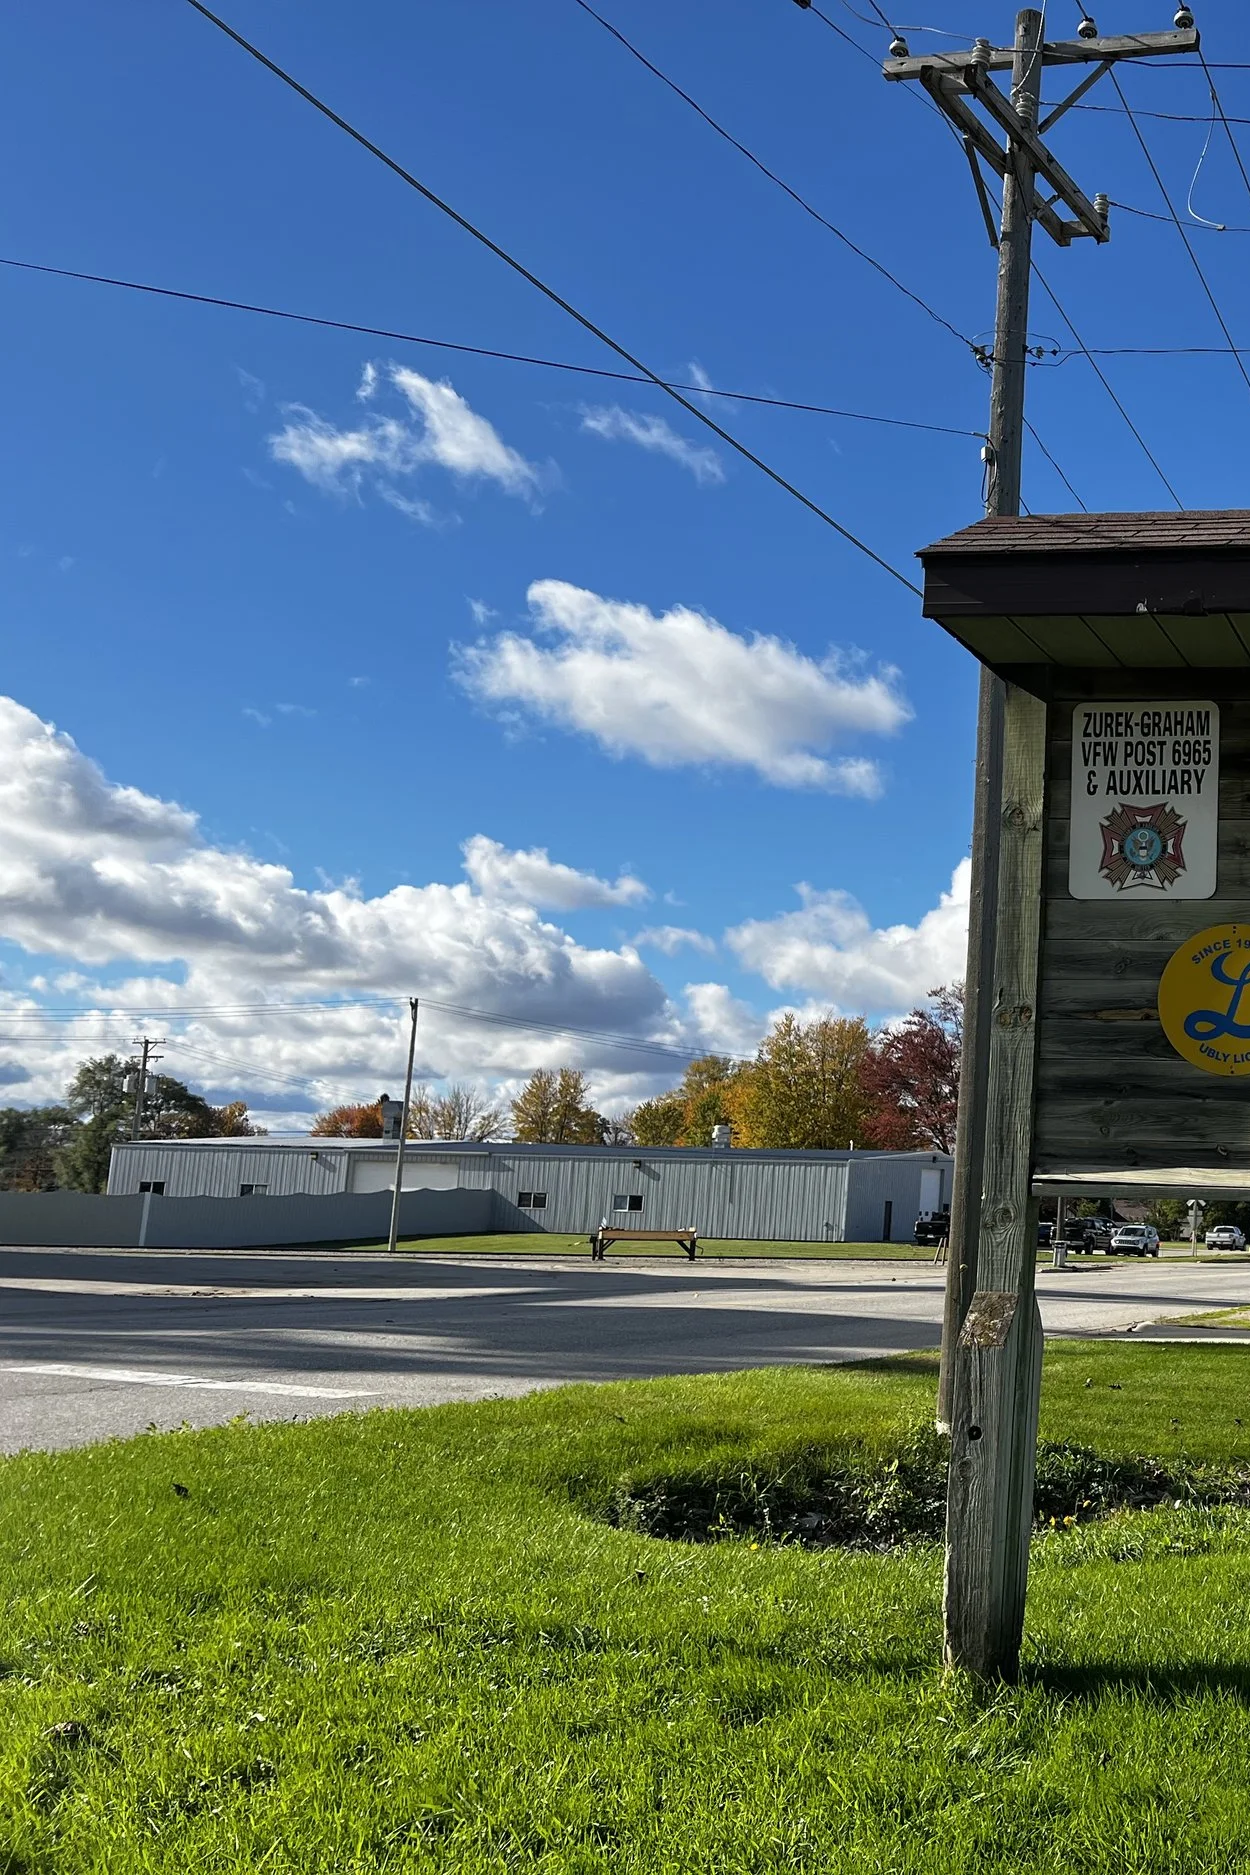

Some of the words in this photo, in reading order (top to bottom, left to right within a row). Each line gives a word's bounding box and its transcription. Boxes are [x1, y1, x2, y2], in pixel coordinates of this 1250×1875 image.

[1083, 710, 1210, 738] ZUREK-GRAHAM
[1081, 741, 1118, 767] VFW
[1123, 740, 1167, 767] POST
[1172, 739, 1212, 766] 6965
[1086, 770, 1098, 795] &
[1105, 768, 1206, 795] AUXILIARY
[1191, 939, 1231, 965] SINCE
[1199, 1043, 1231, 1063] UBLY
